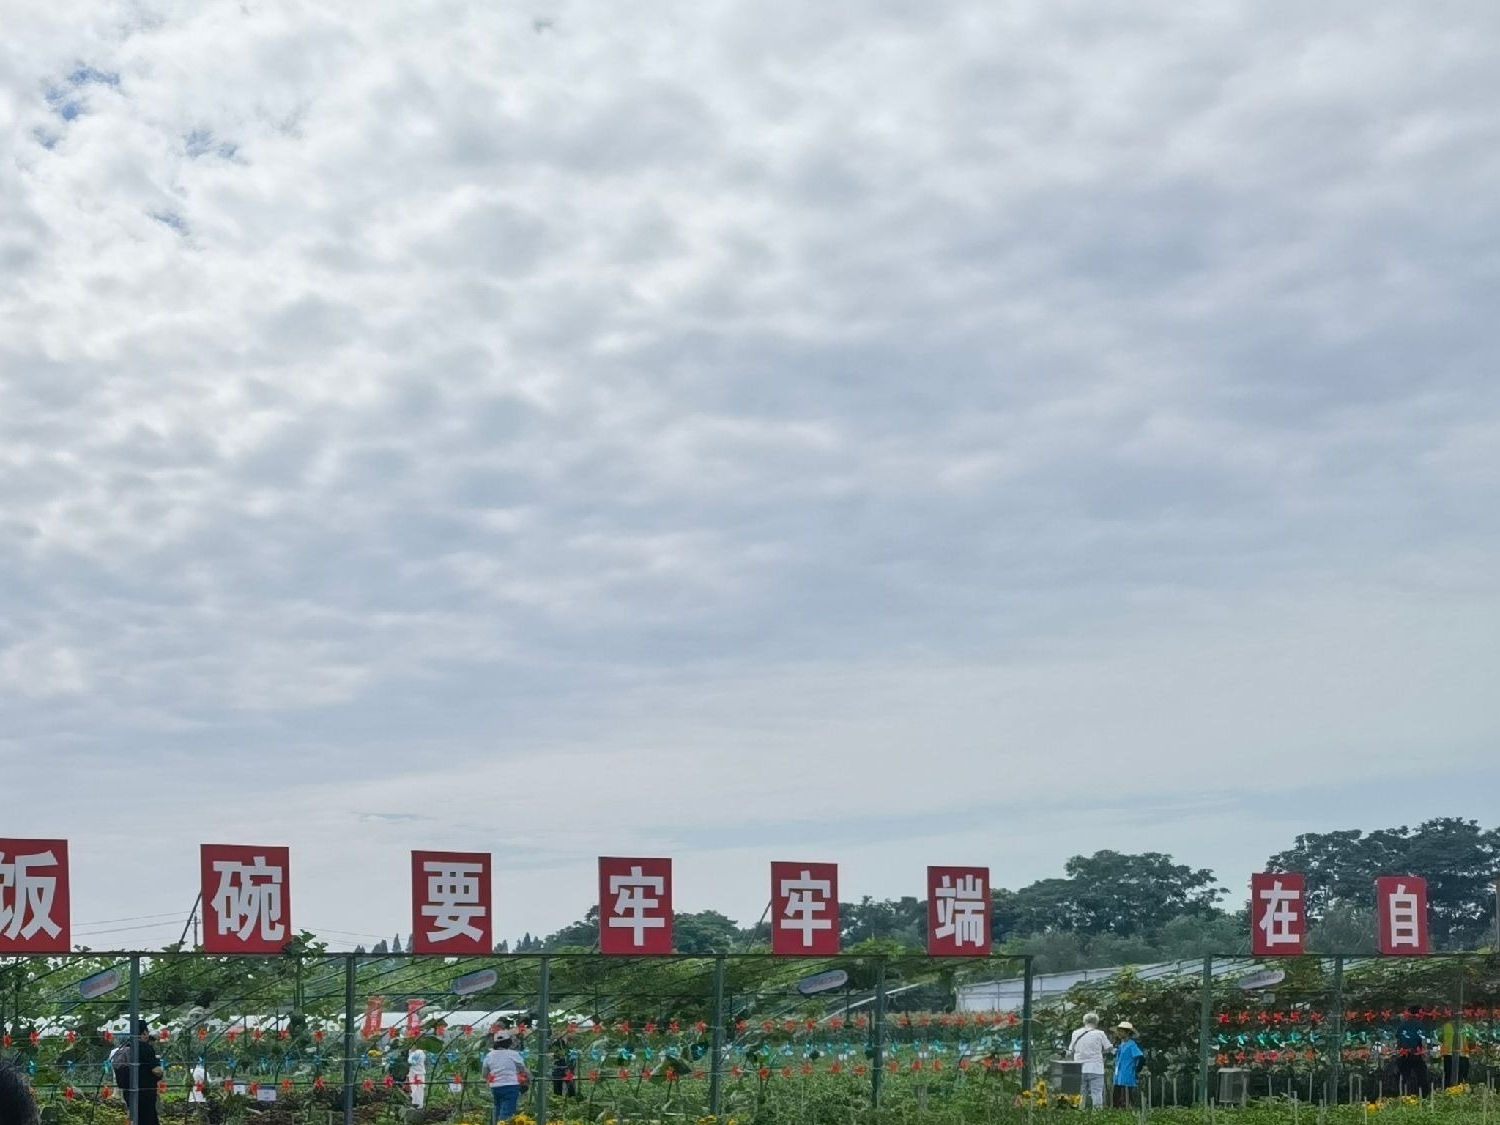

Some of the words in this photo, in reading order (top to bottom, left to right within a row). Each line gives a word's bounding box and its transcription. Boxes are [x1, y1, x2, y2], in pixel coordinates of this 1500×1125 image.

[211, 857, 284, 941] 碗
[422, 862, 485, 942] 要
[609, 867, 664, 946] 牢
[781, 871, 831, 946] 牢
[935, 875, 984, 946] 端
[1260, 881, 1299, 945] 在
[1389, 884, 1419, 946] 自
